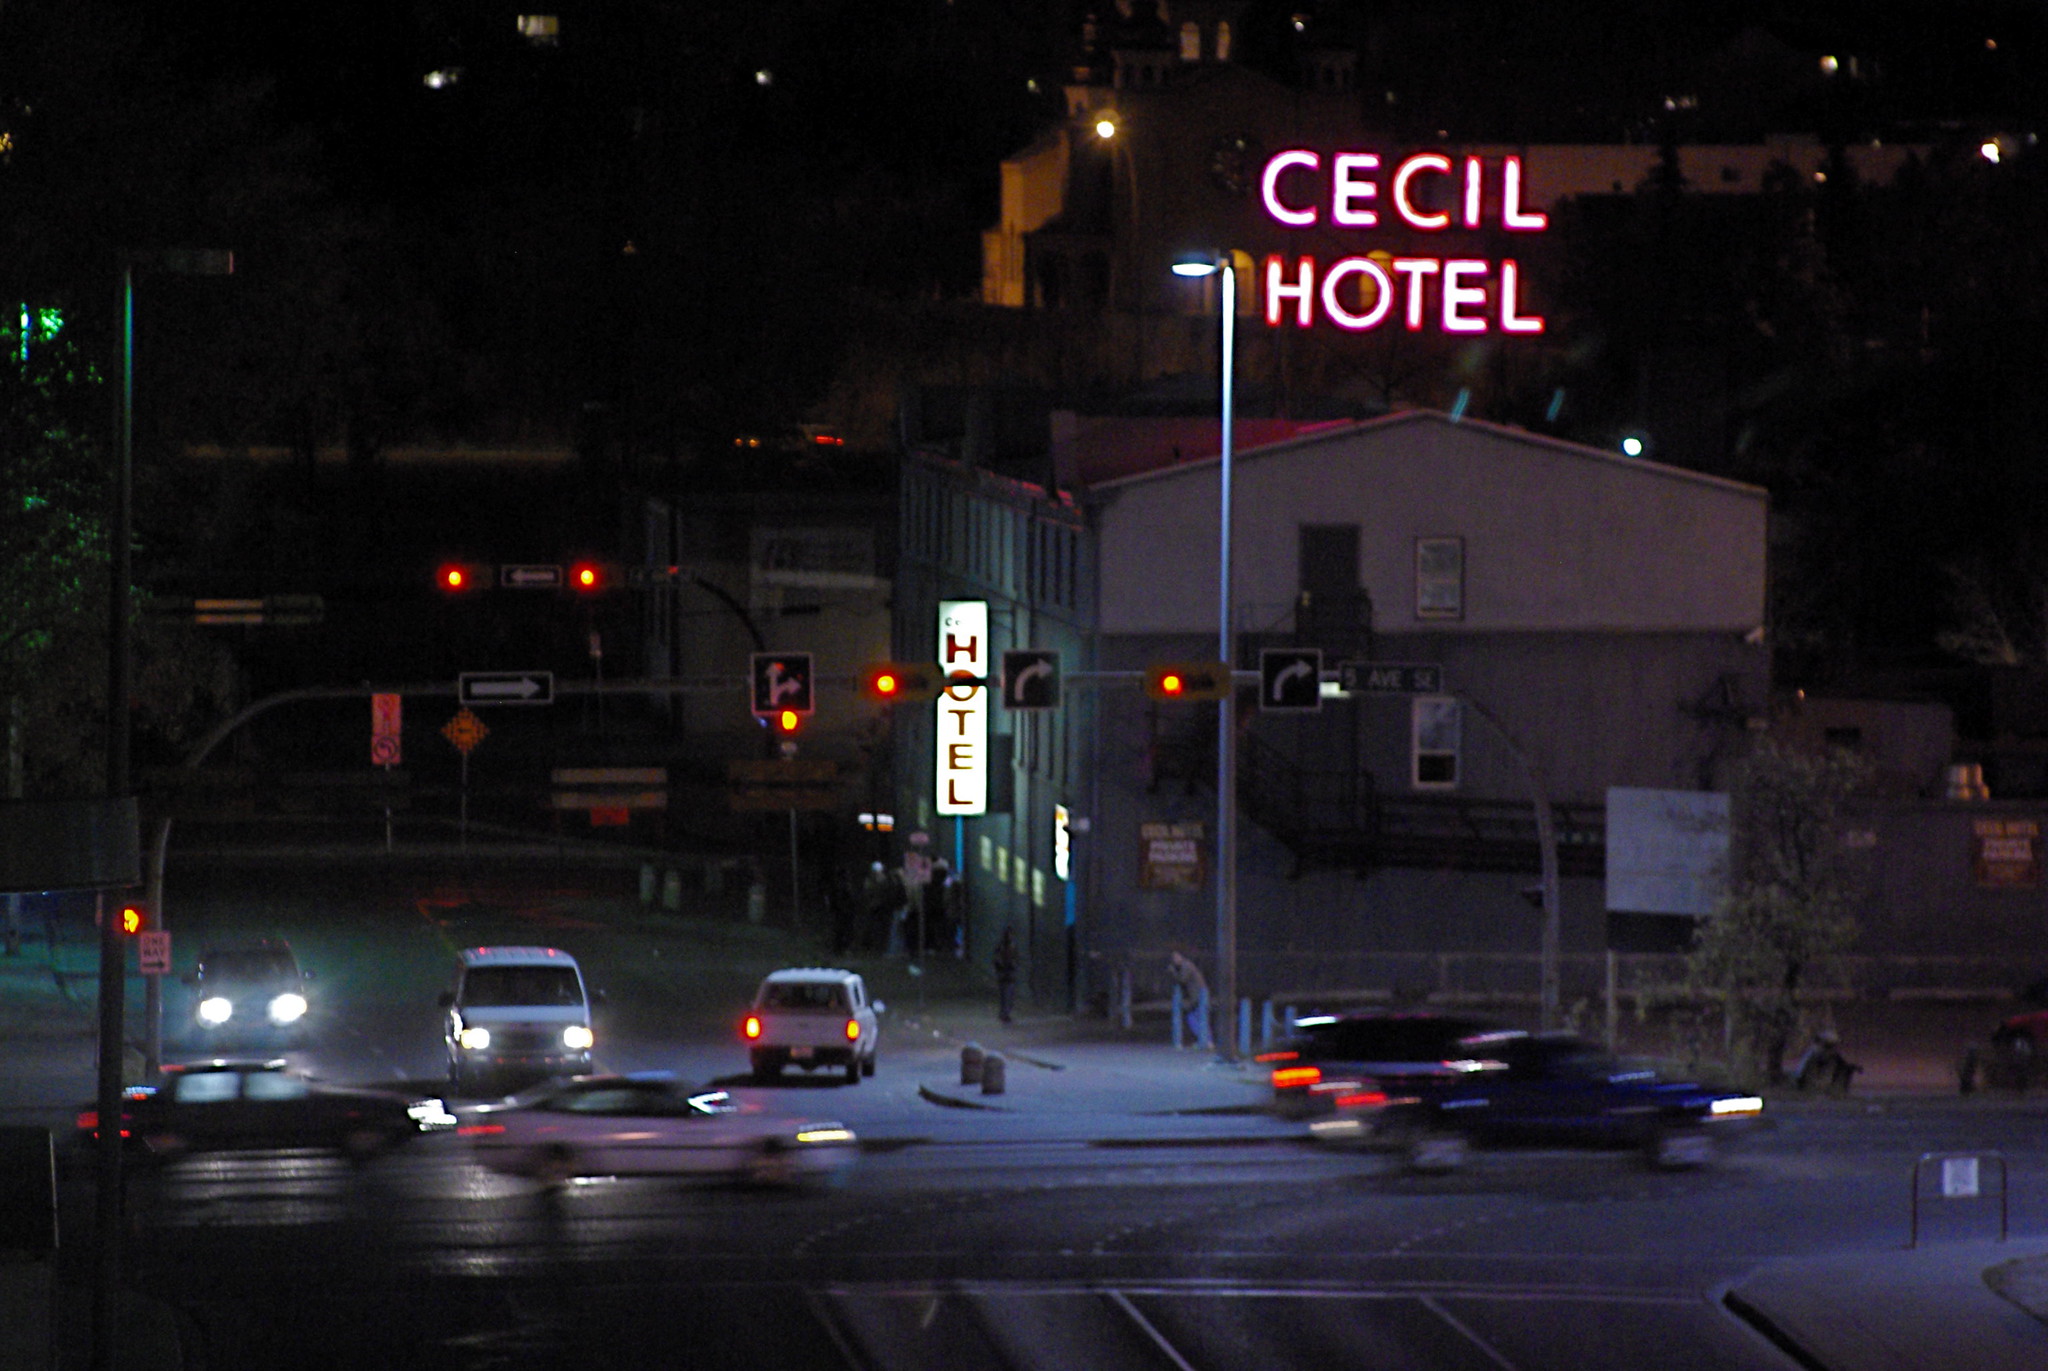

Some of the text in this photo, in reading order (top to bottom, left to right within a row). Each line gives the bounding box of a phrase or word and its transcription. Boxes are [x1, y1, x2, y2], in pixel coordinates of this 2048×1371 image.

[1260, 149, 1548, 231] CECIL
[1265, 255, 1546, 332] HOTEL
[1368, 669, 1402, 688] AVE
[946, 634, 977, 805] HOTEL
